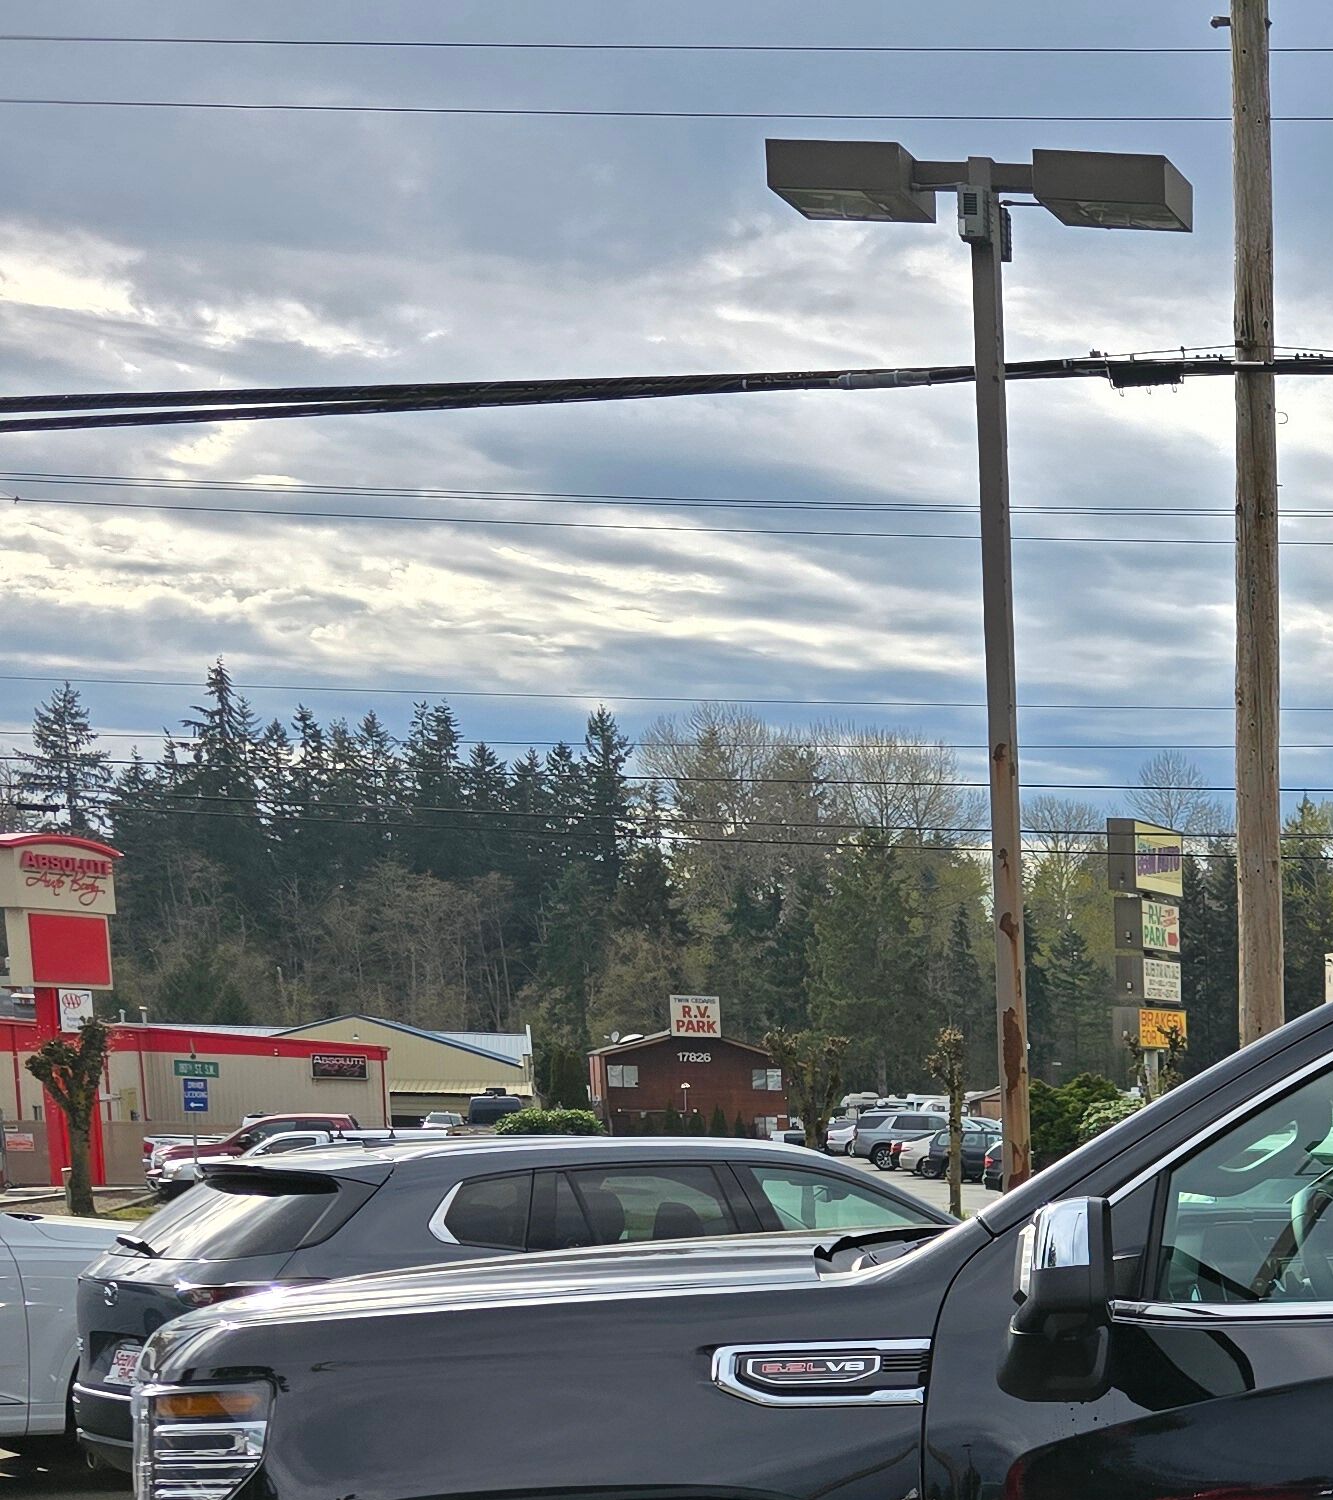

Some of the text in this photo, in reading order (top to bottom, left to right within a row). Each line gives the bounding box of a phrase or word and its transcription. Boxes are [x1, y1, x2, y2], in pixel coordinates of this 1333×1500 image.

[21, 850, 113, 875] ABSOLUTE
[25, 868, 106, 906] Auto Body
[1143, 925, 1168, 947] PARK
[682, 1005, 711, 1018] R.V.
[1141, 1011, 1179, 1027] BRAKES
[675, 1019, 717, 1034] PARK
[313, 1056, 365, 1065] ABSOLUTE
[677, 1052, 712, 1063] 17826
